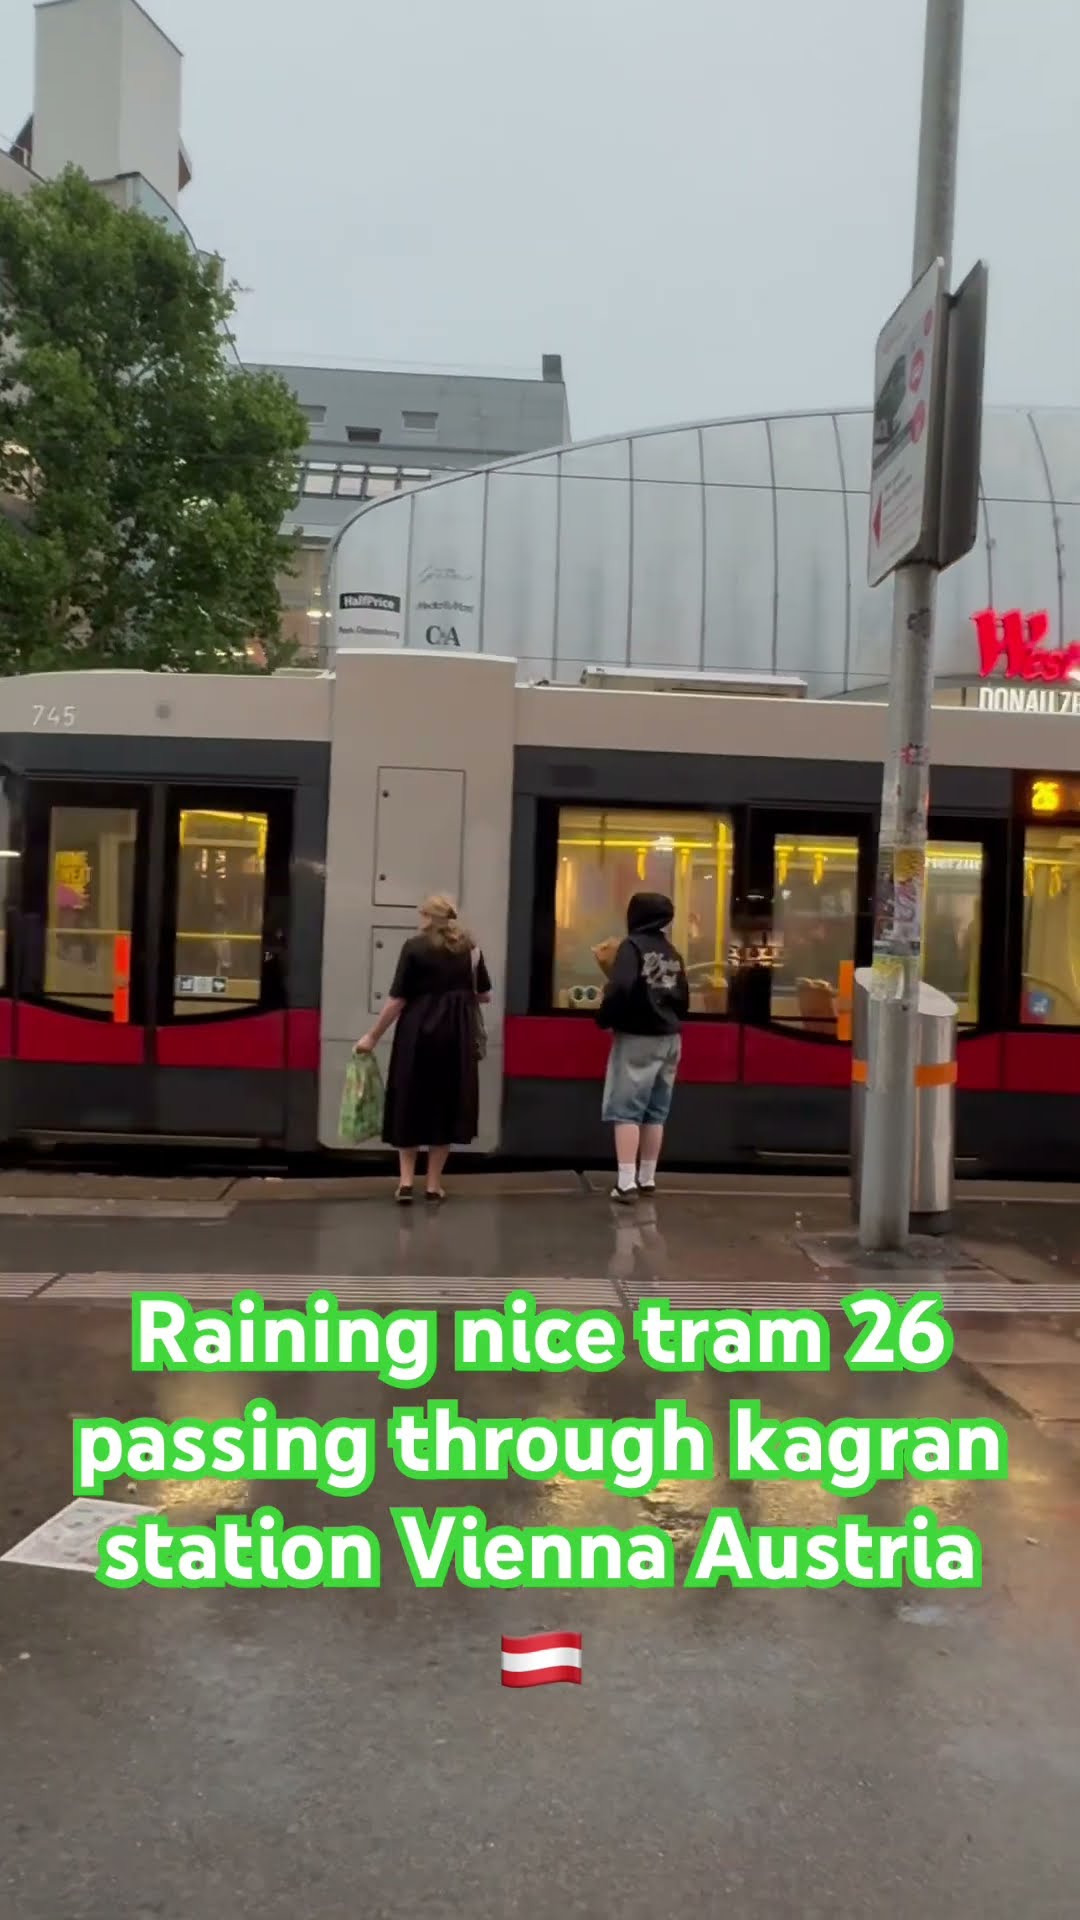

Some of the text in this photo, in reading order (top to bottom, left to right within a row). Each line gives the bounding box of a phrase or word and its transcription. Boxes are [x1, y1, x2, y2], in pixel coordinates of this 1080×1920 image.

[343, 594, 395, 610] HalfPrice
[426, 625, 461, 647] C&A
[32, 704, 77, 727] 745
